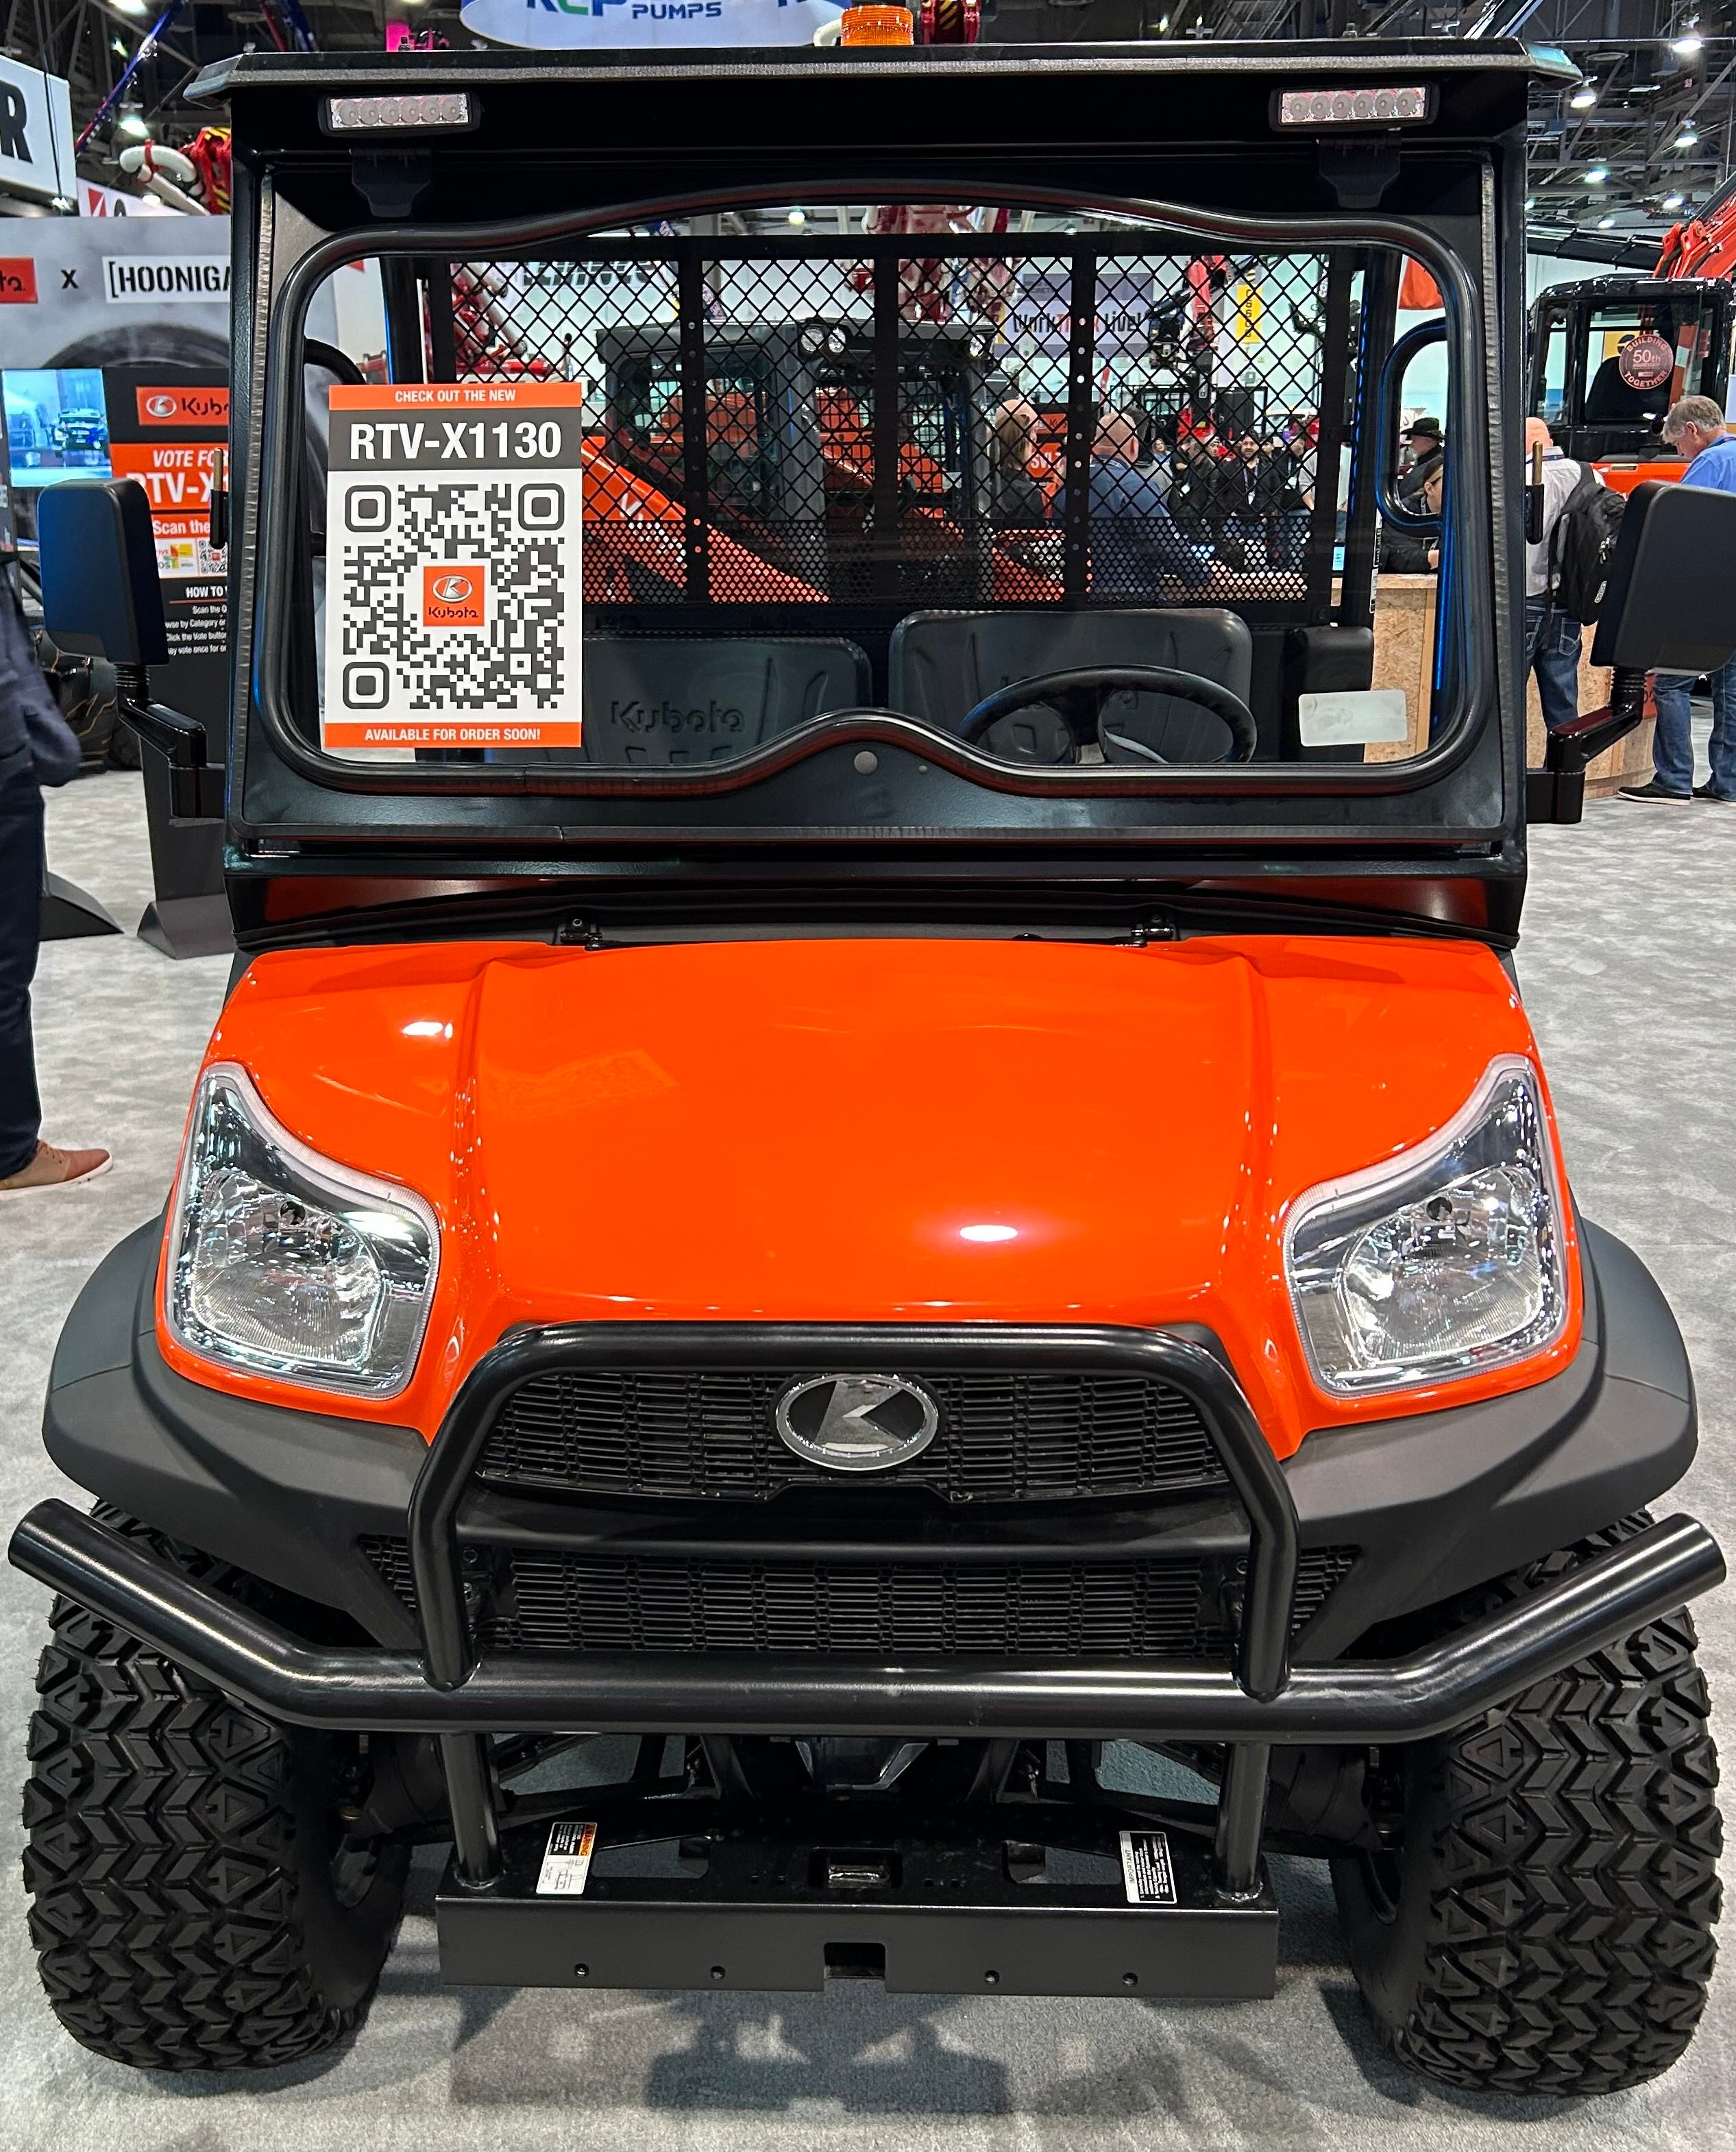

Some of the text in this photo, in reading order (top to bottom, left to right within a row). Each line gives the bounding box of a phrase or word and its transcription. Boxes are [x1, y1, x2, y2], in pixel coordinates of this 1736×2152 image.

[632, 2, 722, 19] PUMPS
[1626, 337, 1667, 352] BUILDING
[1624, 370, 1667, 387] TOGETHER
[395, 389, 517, 403] CHECK OUT THE NEW
[182, 398, 229, 415] Kub
[350, 421, 561, 460] RTV-X1130
[153, 450, 194, 467] VOTE
[153, 519, 210, 535] Scan the
[186, 587, 208, 598] HOW
[210, 585, 223, 597] TO
[428, 607, 479, 618] Kubota
[611, 700, 745, 733] Kubota
[365, 728, 540, 741] AVAILABLE FOR ORDER SOON!
[1125, 1849, 1135, 1883] IMPORTANT
